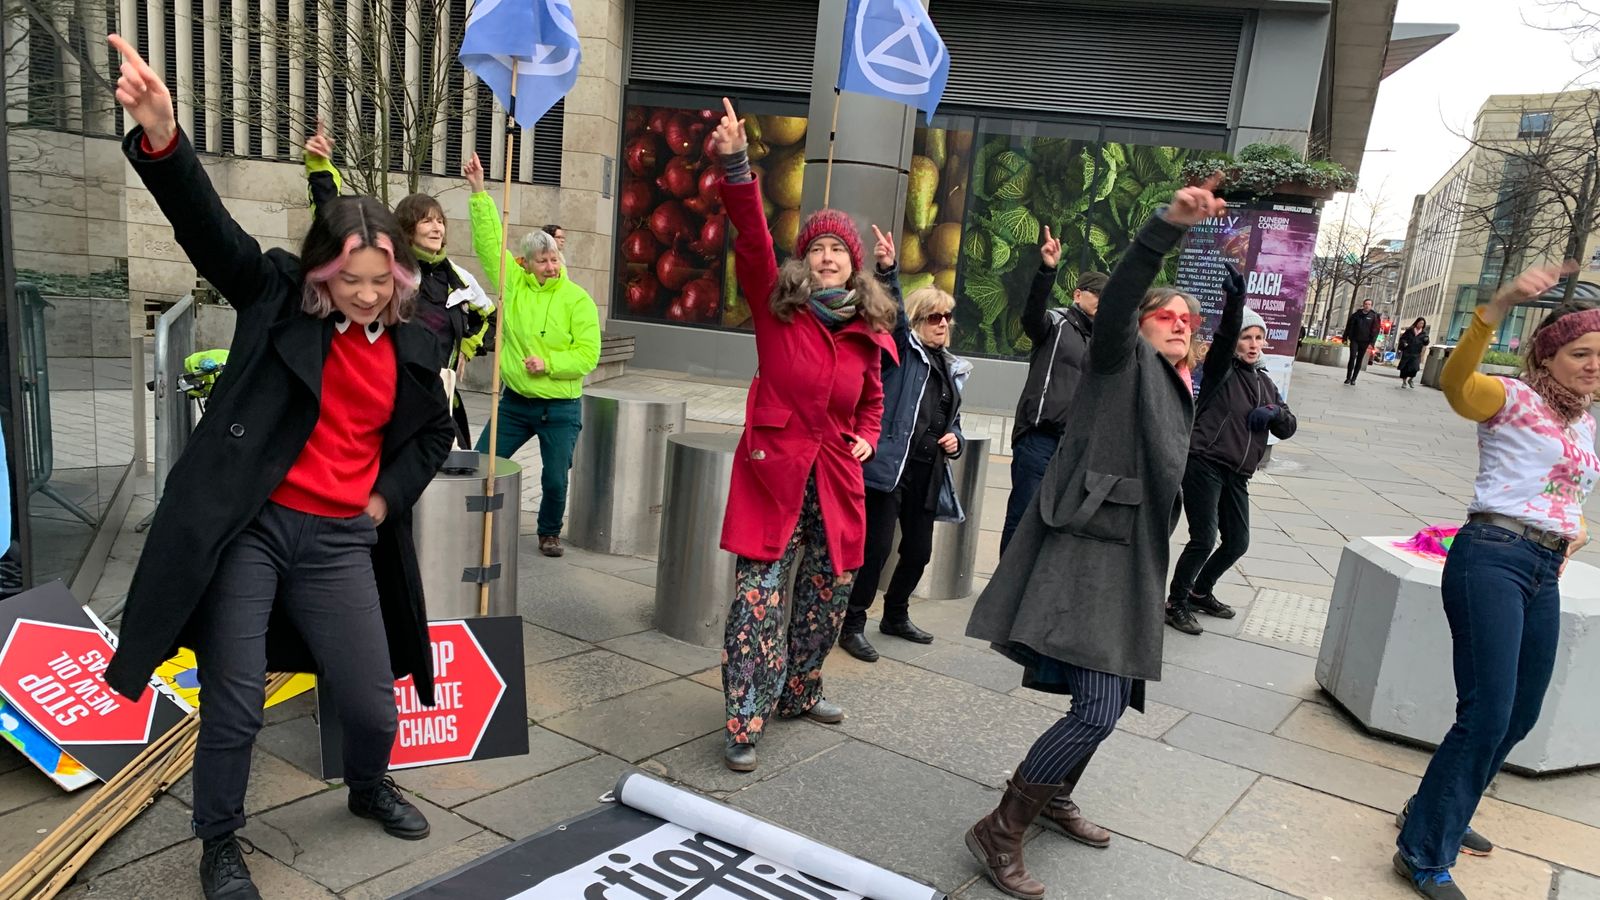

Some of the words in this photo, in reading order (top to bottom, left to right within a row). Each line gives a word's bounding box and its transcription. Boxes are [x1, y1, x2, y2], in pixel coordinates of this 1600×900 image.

[1258, 222, 1289, 231] CONSORT
[1259, 216, 1290, 224] DUNEDIN
[1247, 271, 1283, 296] BACH
[1261, 299, 1286, 312] PASSION
[1268, 329, 1289, 340] PASSION
[47, 650, 82, 680] OIL
[17, 674, 90, 726] STOP
[68, 678, 120, 716] NEW
[399, 714, 458, 748] CHAOS
